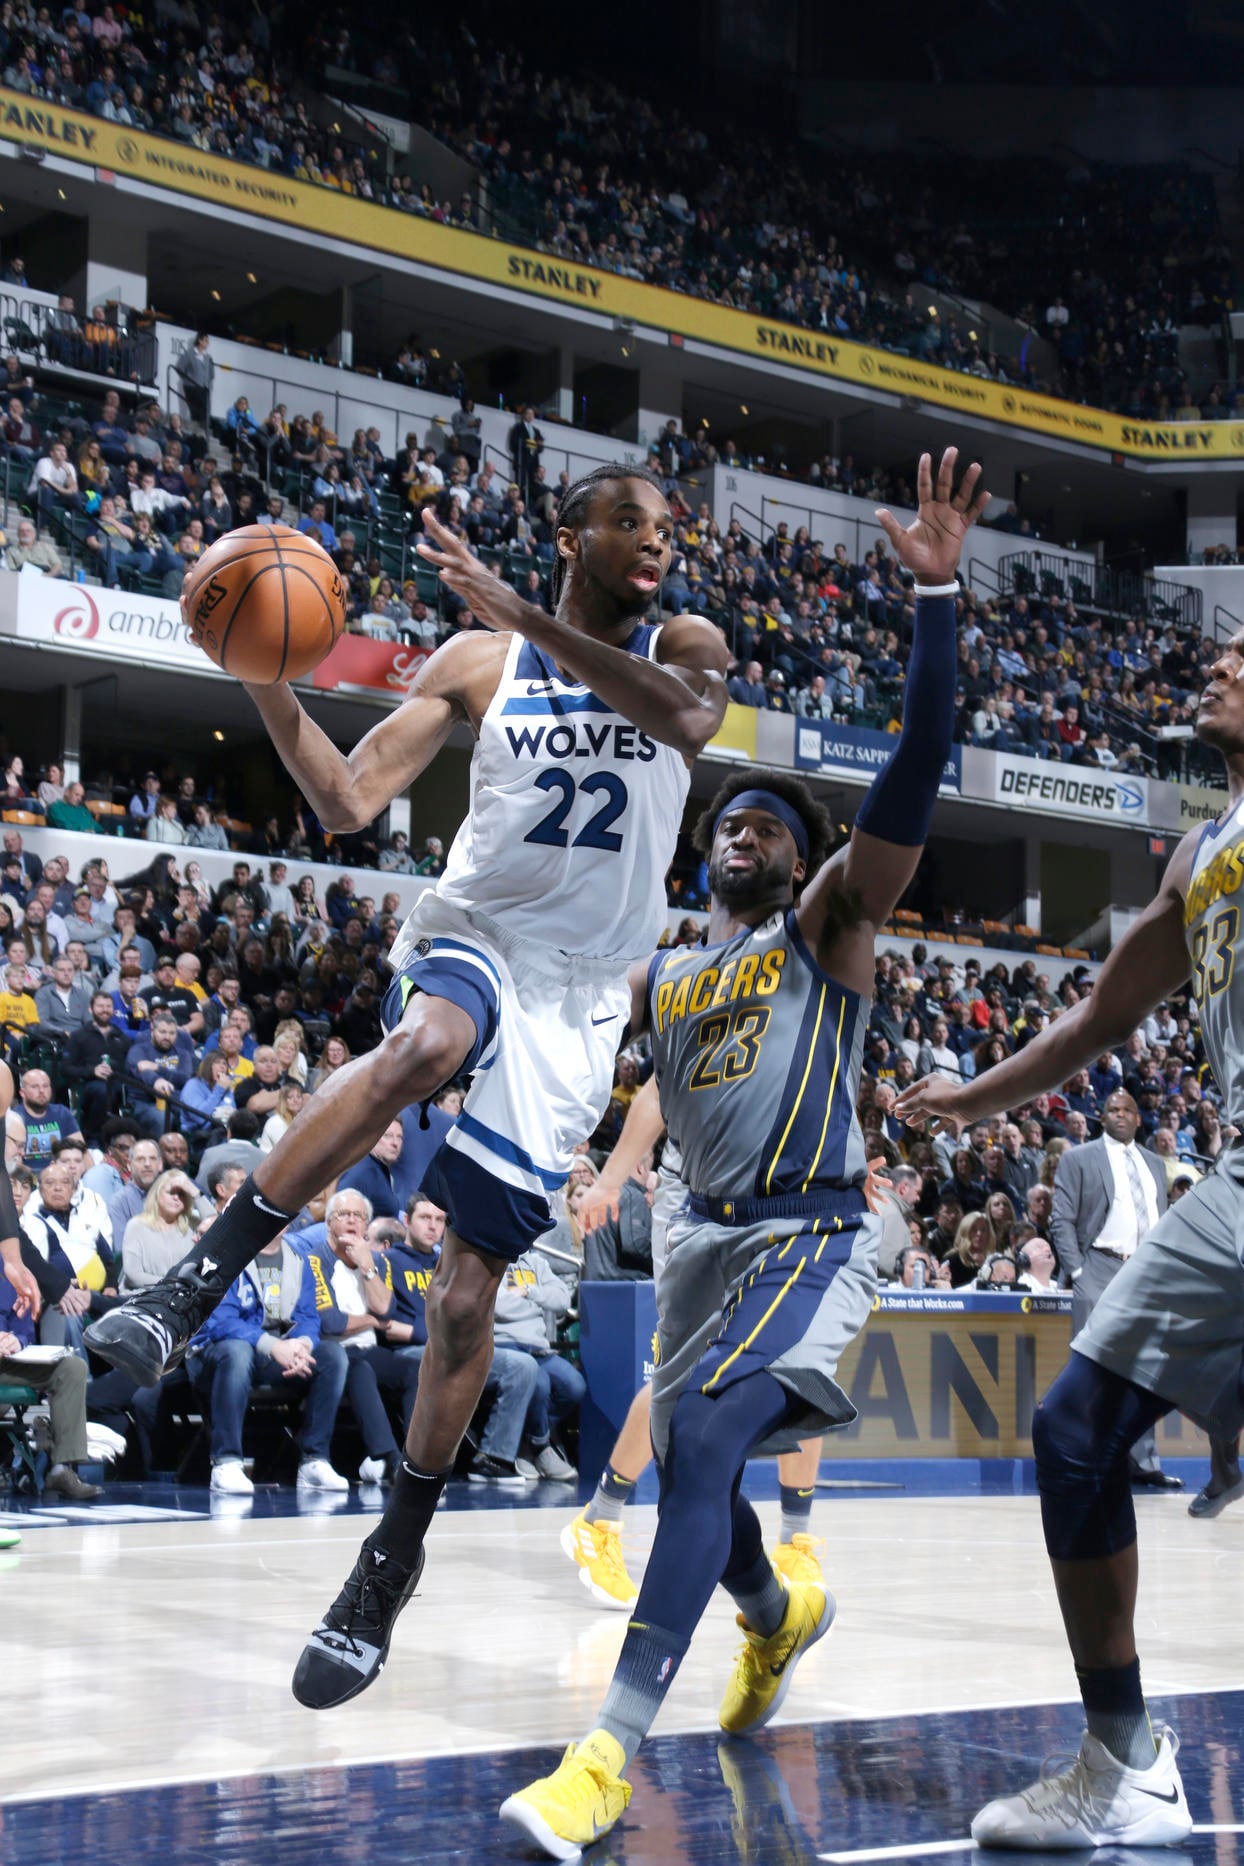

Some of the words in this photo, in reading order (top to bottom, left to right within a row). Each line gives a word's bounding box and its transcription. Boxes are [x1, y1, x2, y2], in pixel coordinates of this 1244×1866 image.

[0, 101, 96, 150] ANLEY
[145, 150, 231, 187] INTEGRATED
[235, 178, 297, 206] SECURITY
[507, 255, 602, 298] STANLEY
[756, 325, 839, 366] STANLEY
[1121, 425, 1213, 449] STANLEY
[505, 723, 657, 763] WOLVES
[823, 740, 854, 762] KATZ
[524, 767, 629, 853] 22
[1001, 768, 1117, 811] DEFENDERS
[657, 949, 787, 1035] PACERS
[689, 1005, 772, 1091] 23
[880, 1297, 888, 1309] A
[887, 1297, 907, 1309] State
[907, 1297, 924, 1310] that
[923, 1297, 965, 1311] Works.com
